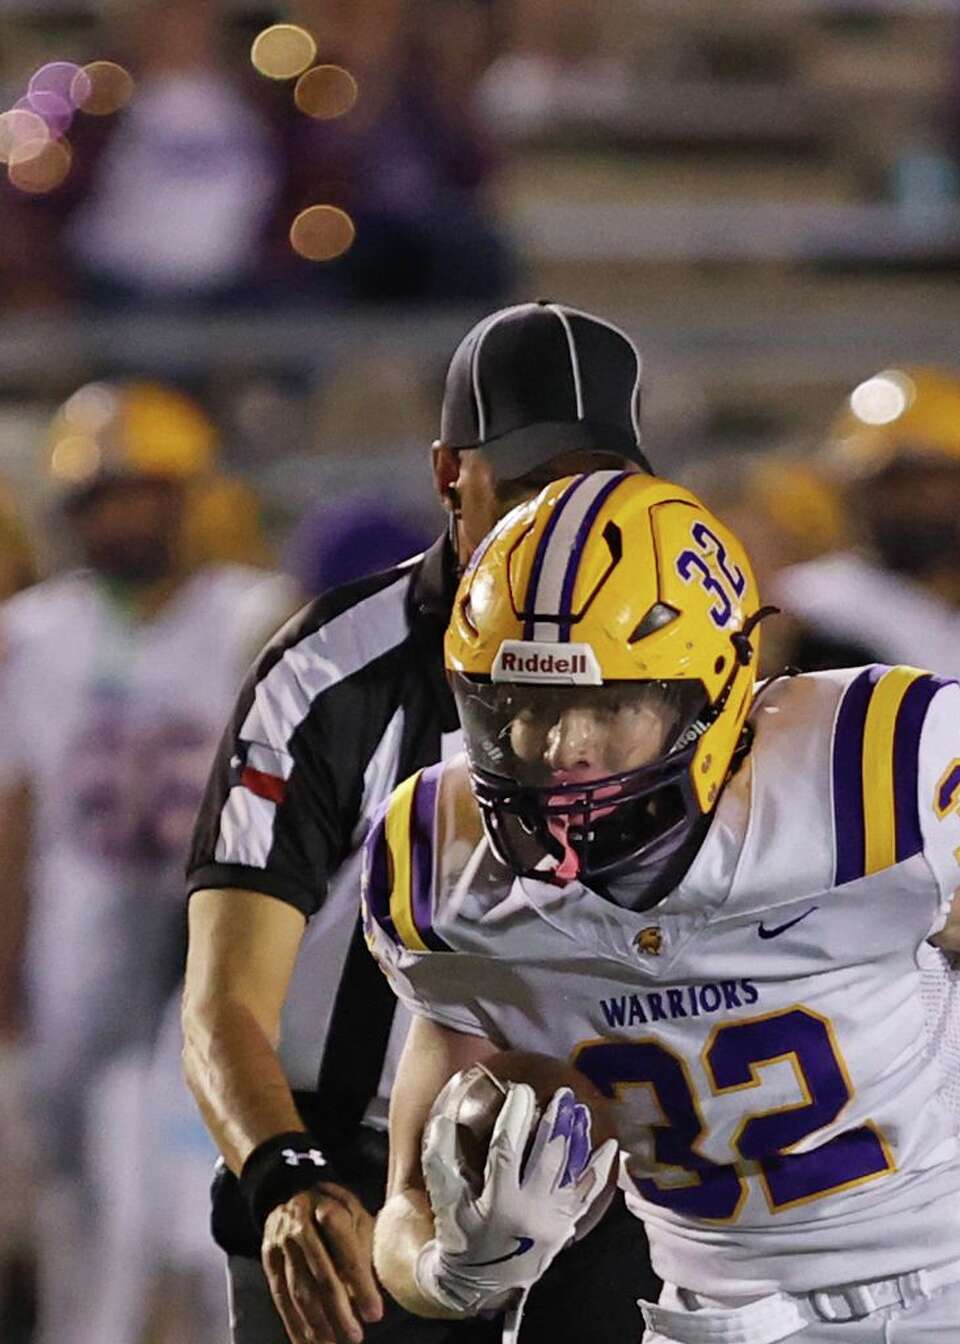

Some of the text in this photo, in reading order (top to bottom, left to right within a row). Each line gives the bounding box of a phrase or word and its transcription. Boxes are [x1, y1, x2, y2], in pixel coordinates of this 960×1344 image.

[673, 519, 746, 630] 32
[501, 652, 587, 674] Riddell
[600, 978, 759, 1028] WARRIORS
[572, 1004, 897, 1225] 32
